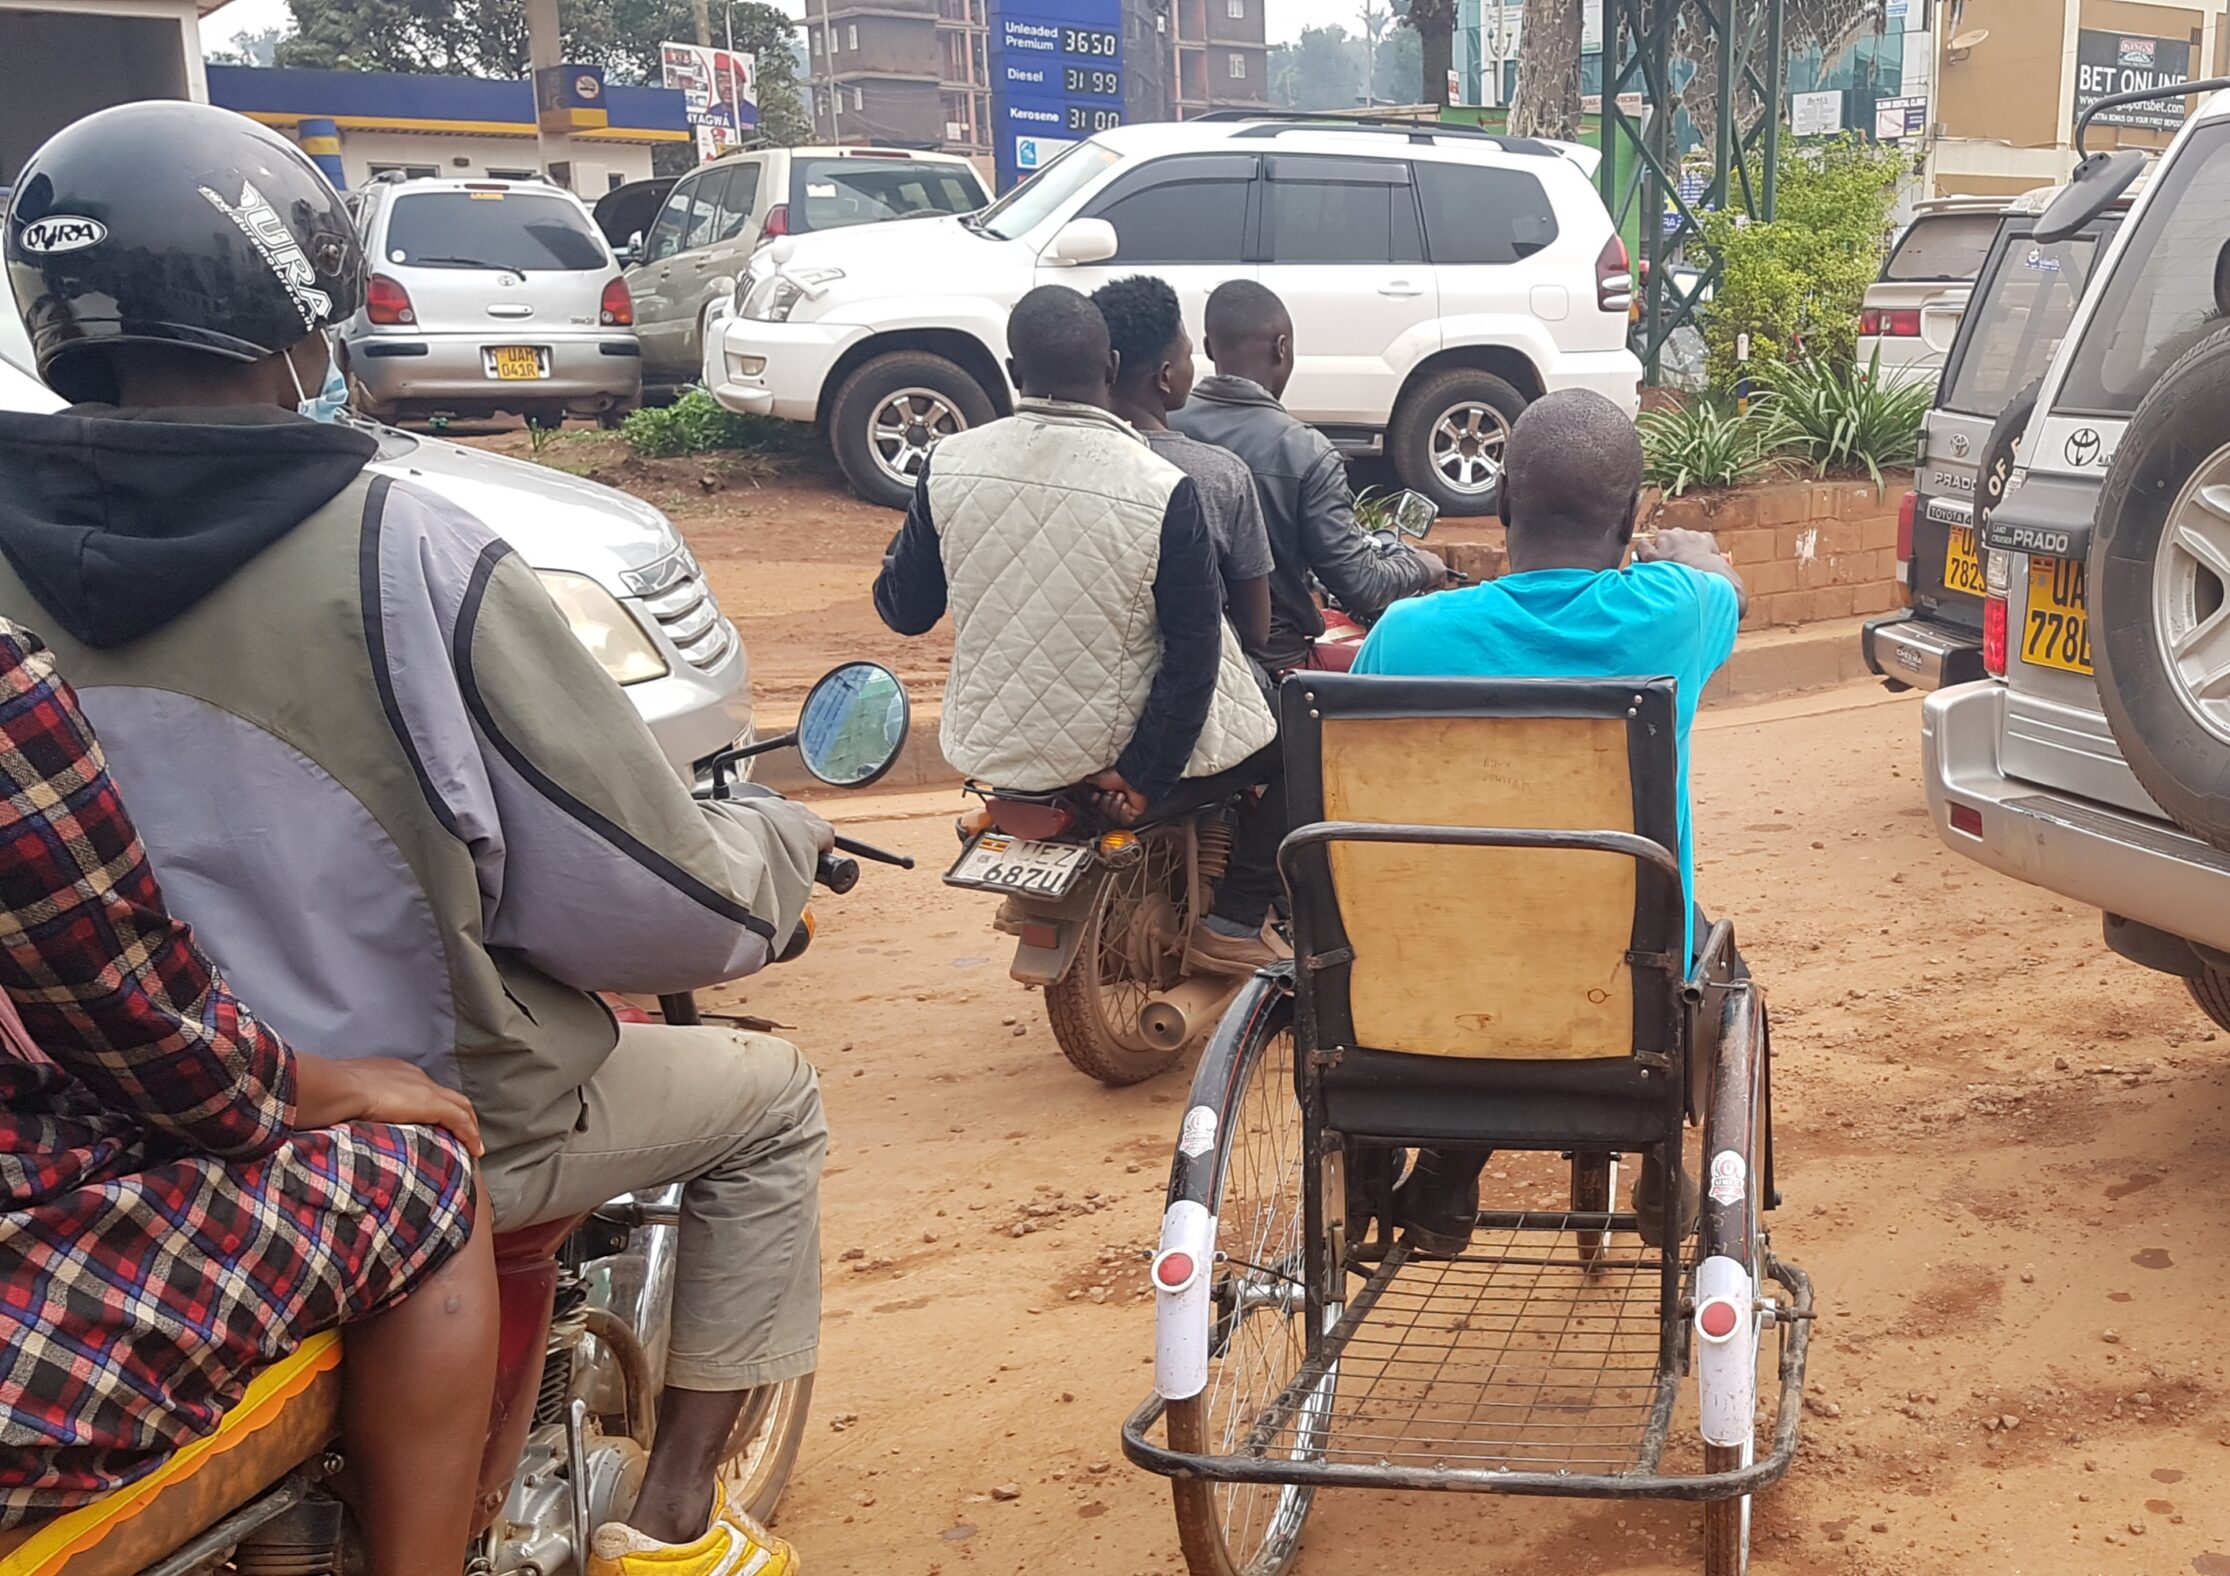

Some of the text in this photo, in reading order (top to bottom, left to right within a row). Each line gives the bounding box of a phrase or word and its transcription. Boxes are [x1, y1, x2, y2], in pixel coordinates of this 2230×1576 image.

[1005, 21, 1058, 38] Unleaded
[1006, 30, 1116, 56] Premium 3650
[1007, 67, 1043, 82] Diesel
[2080, 64, 2117, 93] BET
[1009, 107, 1060, 122] Kerosene
[502, 363, 536, 377] 041R
[1930, 506, 1962, 525] TOYOTA
[1992, 522, 2007, 535] LAND
[1991, 533, 2013, 545] CRUISER
[2012, 528, 2069, 553] PRADO
[2052, 560, 2086, 610] UA
[982, 862, 1064, 891] 687U
